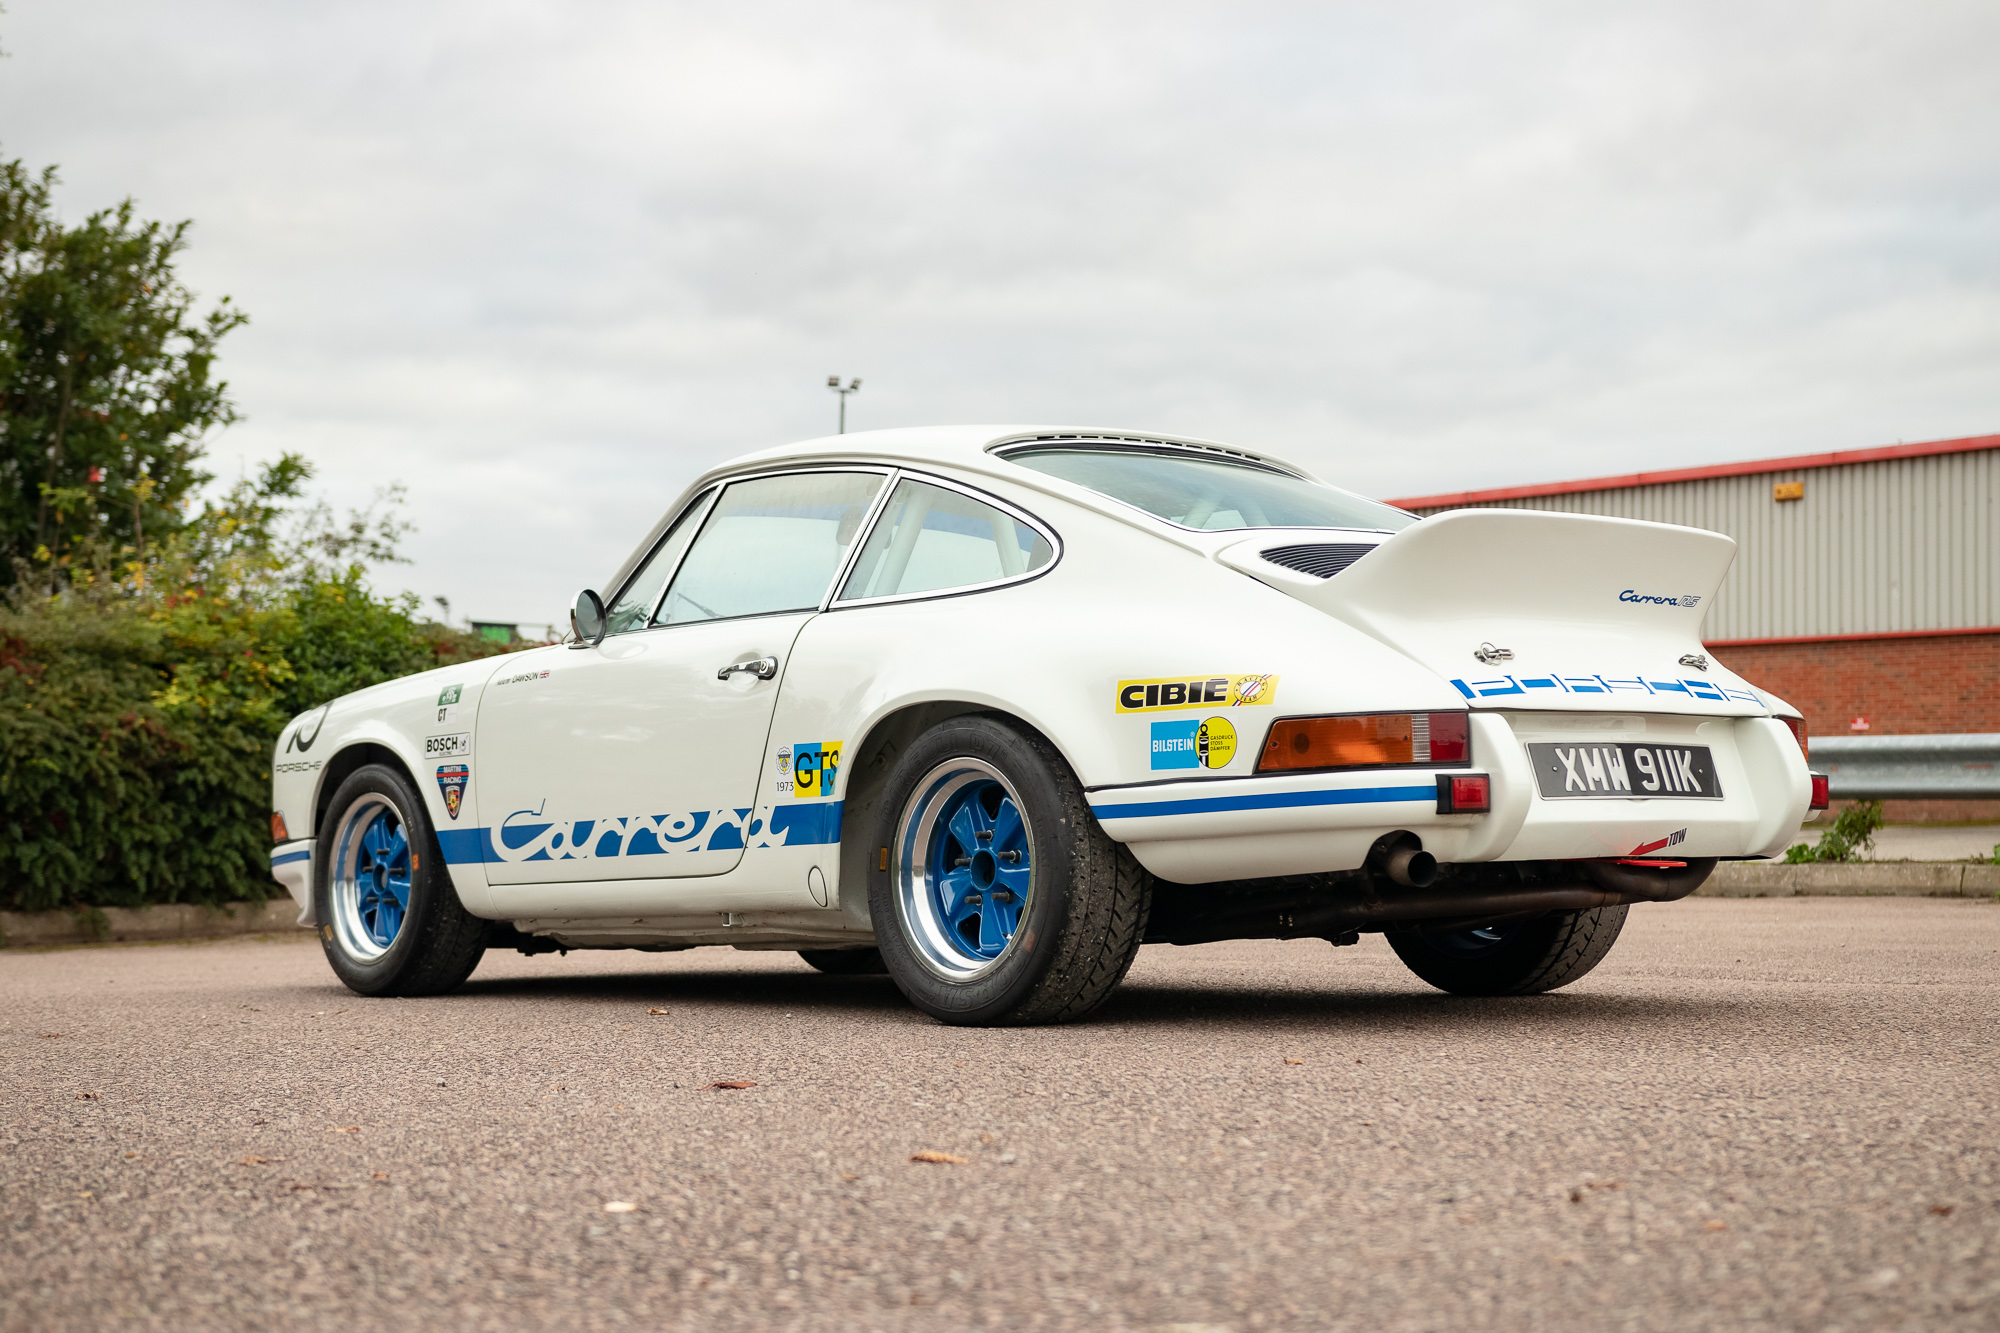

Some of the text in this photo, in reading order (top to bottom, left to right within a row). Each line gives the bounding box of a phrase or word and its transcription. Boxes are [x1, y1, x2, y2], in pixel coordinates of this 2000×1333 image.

[1619, 590, 1701, 607] Carrera RS
[426, 736, 458, 752] BOSCH
[276, 761, 322, 773] PORSCHE
[443, 765, 462, 773] MARTINI
[795, 750, 839, 788] GTS
[1555, 747, 1703, 793] XMW 911K
[443, 776, 462, 784] RACING
[776, 782, 794, 792] 1973
[490, 798, 789, 862] Carrera
[1668, 827, 1687, 847] TOW
